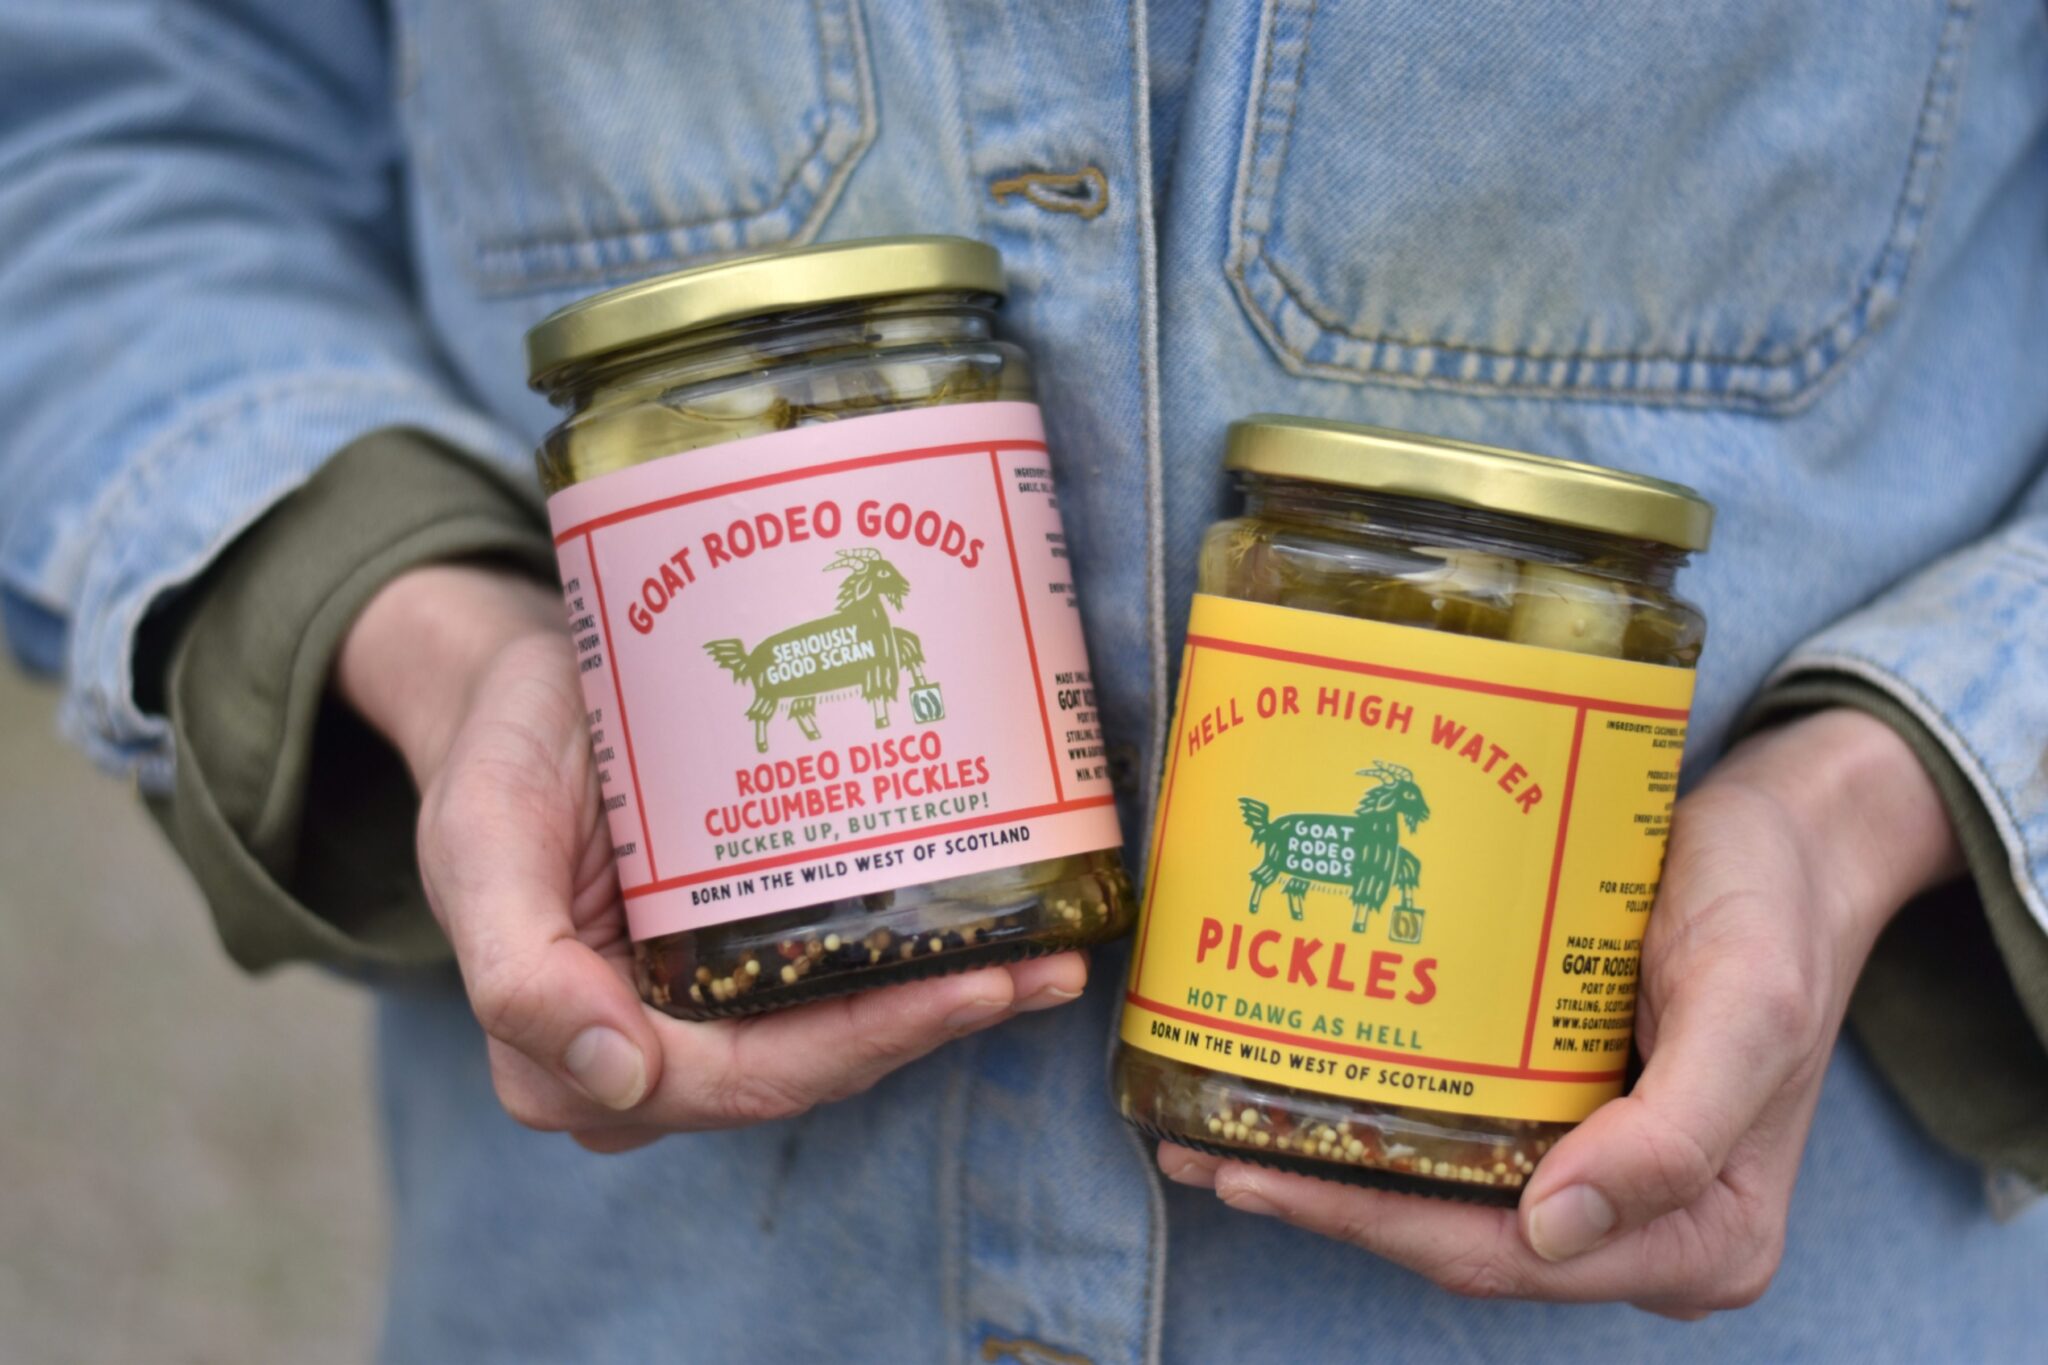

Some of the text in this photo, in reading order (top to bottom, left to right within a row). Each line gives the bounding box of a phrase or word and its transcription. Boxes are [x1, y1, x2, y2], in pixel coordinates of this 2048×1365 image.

[627, 500, 985, 635] GOAT RODEO GOODS
[772, 625, 858, 664] SERIOUSLY
[766, 640, 876, 685] GOOD SCRAN
[1055, 671, 1073, 685] MADE
[1058, 688, 1081, 711] GOAT
[1187, 685, 1544, 815] HELL OR HIGH WATER
[736, 730, 942, 797] RODEO DISCO
[1076, 767, 1094, 781] MIN.
[704, 756, 991, 837] CUCUMBER PICKLES
[714, 791, 991, 861] PUCKER UP, BUTTERCUP!
[1295, 820, 1355, 842] GOAT
[1287, 837, 1355, 862] RODEO
[691, 826, 1031, 906] BORN IN THE WILD WEST OF SCOTLAND
[1286, 854, 1353, 878] GOODS
[1600, 881, 1617, 893] FOR
[1566, 936, 1595, 950] MADE
[1598, 938, 1622, 951] SMALL
[1196, 917, 1438, 1005] PICKLES
[1562, 954, 1637, 977] GOAT RODEO
[1580, 982, 1604, 995] PORT
[1606, 983, 1617, 995] OF
[1187, 986, 1424, 1050] HOT DAWG AS HELL
[1555, 998, 1602, 1013] STIRLING,
[1553, 1037, 1578, 1051] MIN.
[1581, 1038, 1601, 1052] NET
[1151, 1020, 1475, 1097] BORN IN THE WILD WEST OF SCOTLAND
